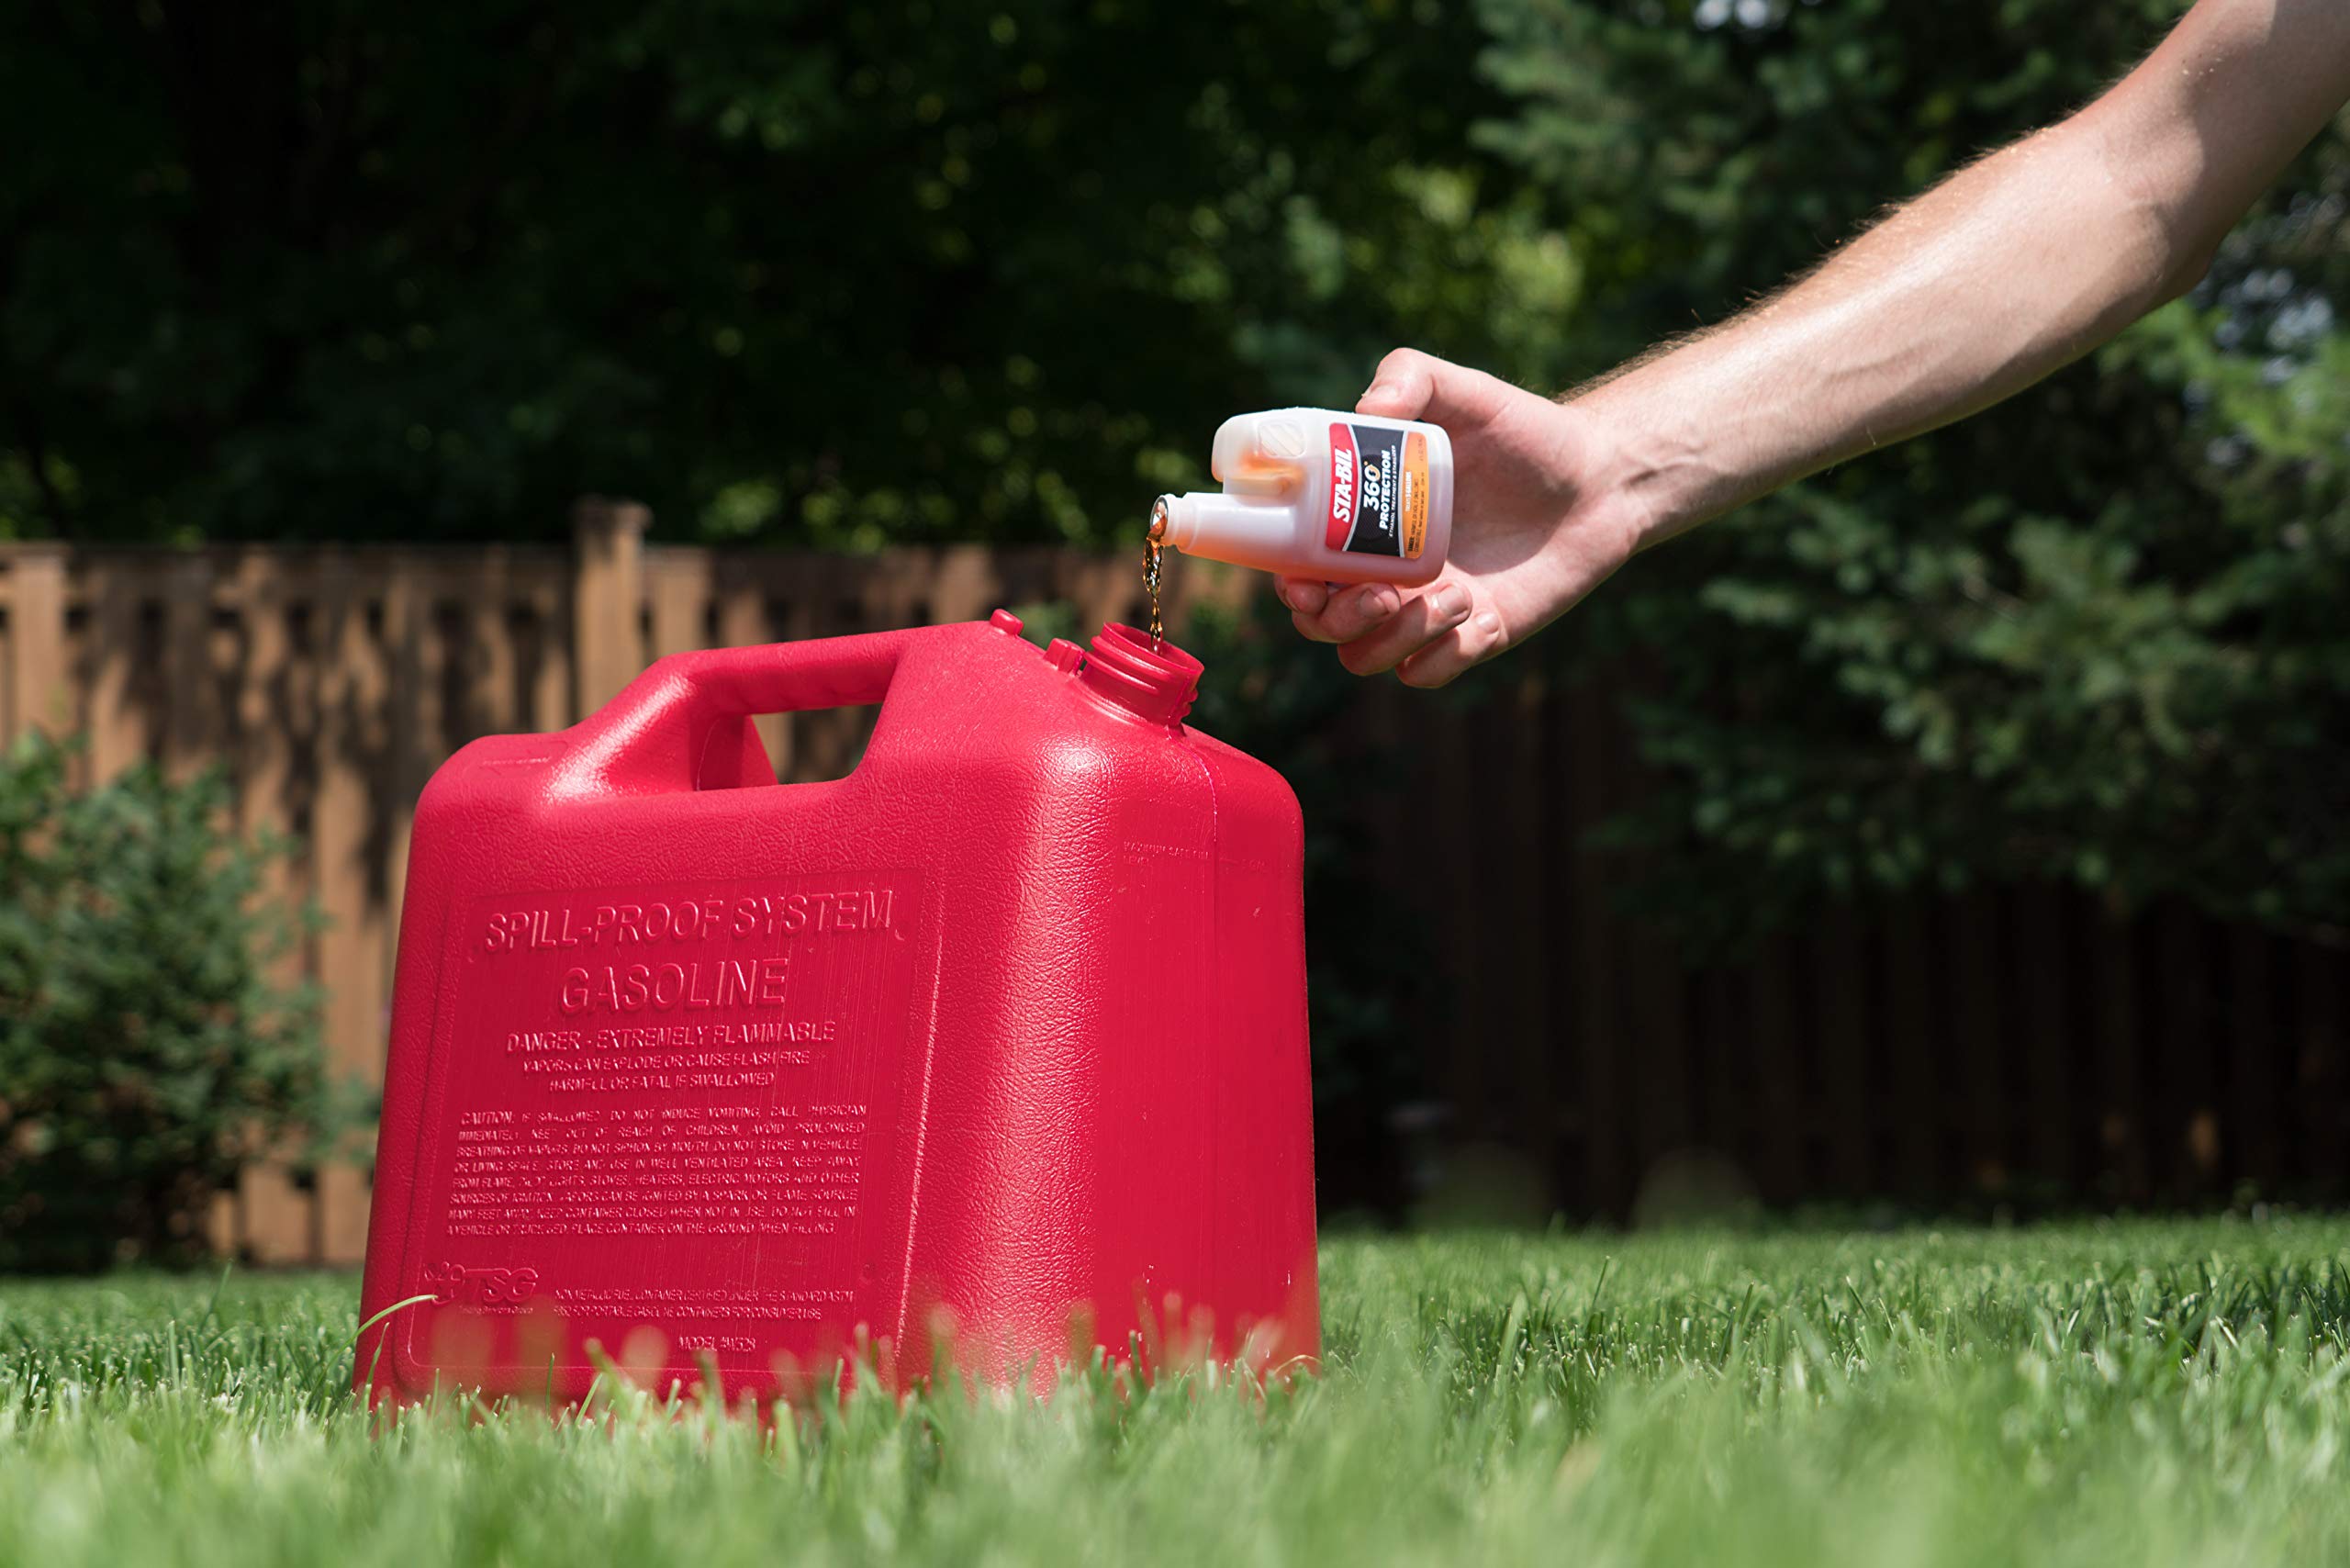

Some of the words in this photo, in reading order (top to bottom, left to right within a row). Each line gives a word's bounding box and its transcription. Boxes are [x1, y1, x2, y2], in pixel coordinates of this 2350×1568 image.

[1333, 447, 1352, 523] STA-BIL
[1380, 450, 1391, 530] PROTECTION
[486, 899, 723, 954] SPILL-PROOF
[733, 890, 894, 939] SYSTEM
[561, 958, 789, 1015] GASOLINE
[507, 1030, 581, 1052] DANGER
[597, 1025, 709, 1050] EXTREMELY
[713, 1021, 836, 1045] FLAMMABLE
[575, 1058, 601, 1071] CAN
[603, 1056, 662, 1070] EXPLODE
[664, 1054, 684, 1068] OR
[687, 1053, 732, 1068] CAUSE
[734, 1051, 777, 1066] FLASH
[780, 1050, 811, 1064] FIRE
[610, 1076, 630, 1090] OR
[632, 1075, 671, 1089] FATAL
[675, 1074, 687, 1087] IF
[689, 1072, 775, 1087] SWALLOWED
[610, 1110, 626, 1121] DO
[633, 1108, 655, 1120] NOT
[661, 1107, 702, 1119] INDUCE
[770, 1105, 799, 1116] CALL
[688, 1172, 740, 1184] ELECTRIC
